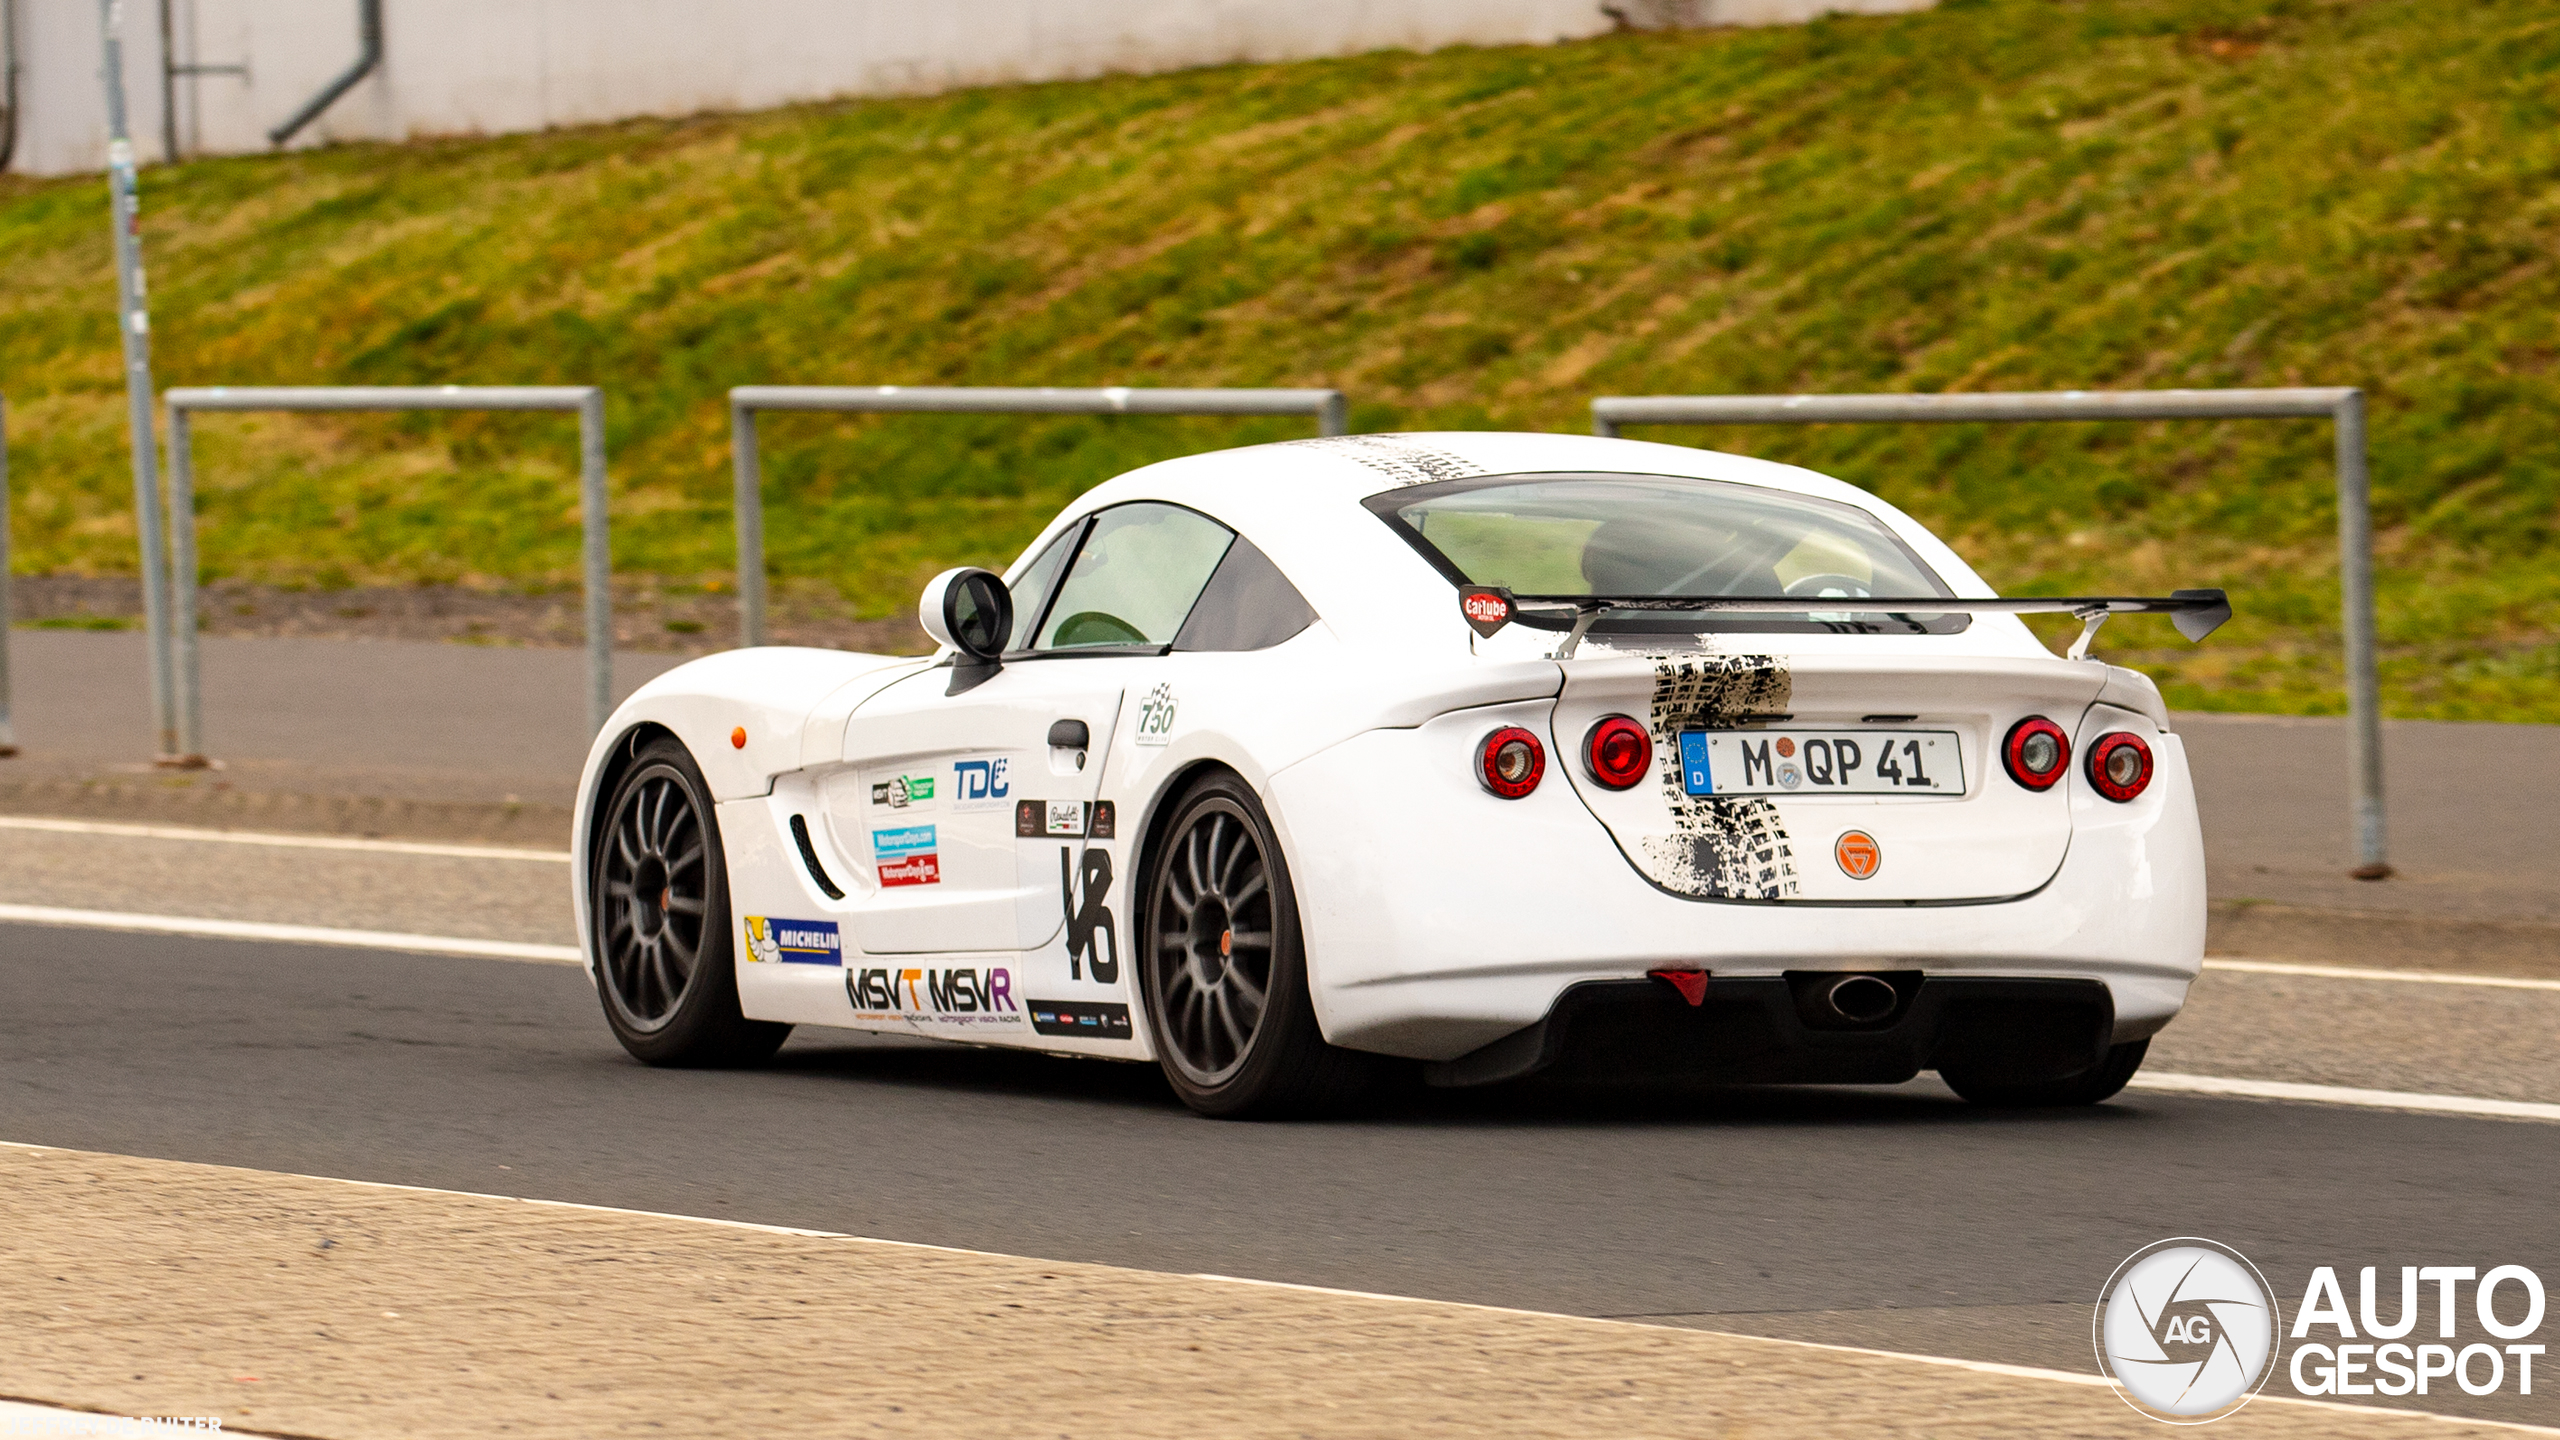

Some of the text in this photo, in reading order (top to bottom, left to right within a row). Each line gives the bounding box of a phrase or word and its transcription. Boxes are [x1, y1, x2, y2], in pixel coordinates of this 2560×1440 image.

[1140, 704, 1174, 734] 750
[1692, 771, 1704, 786] D
[1741, 739, 1932, 786] M QP 41
[780, 930, 840, 949] MICHELIN
[845, 968, 922, 1011] MSVT
[928, 968, 1018, 1012] MSVR
